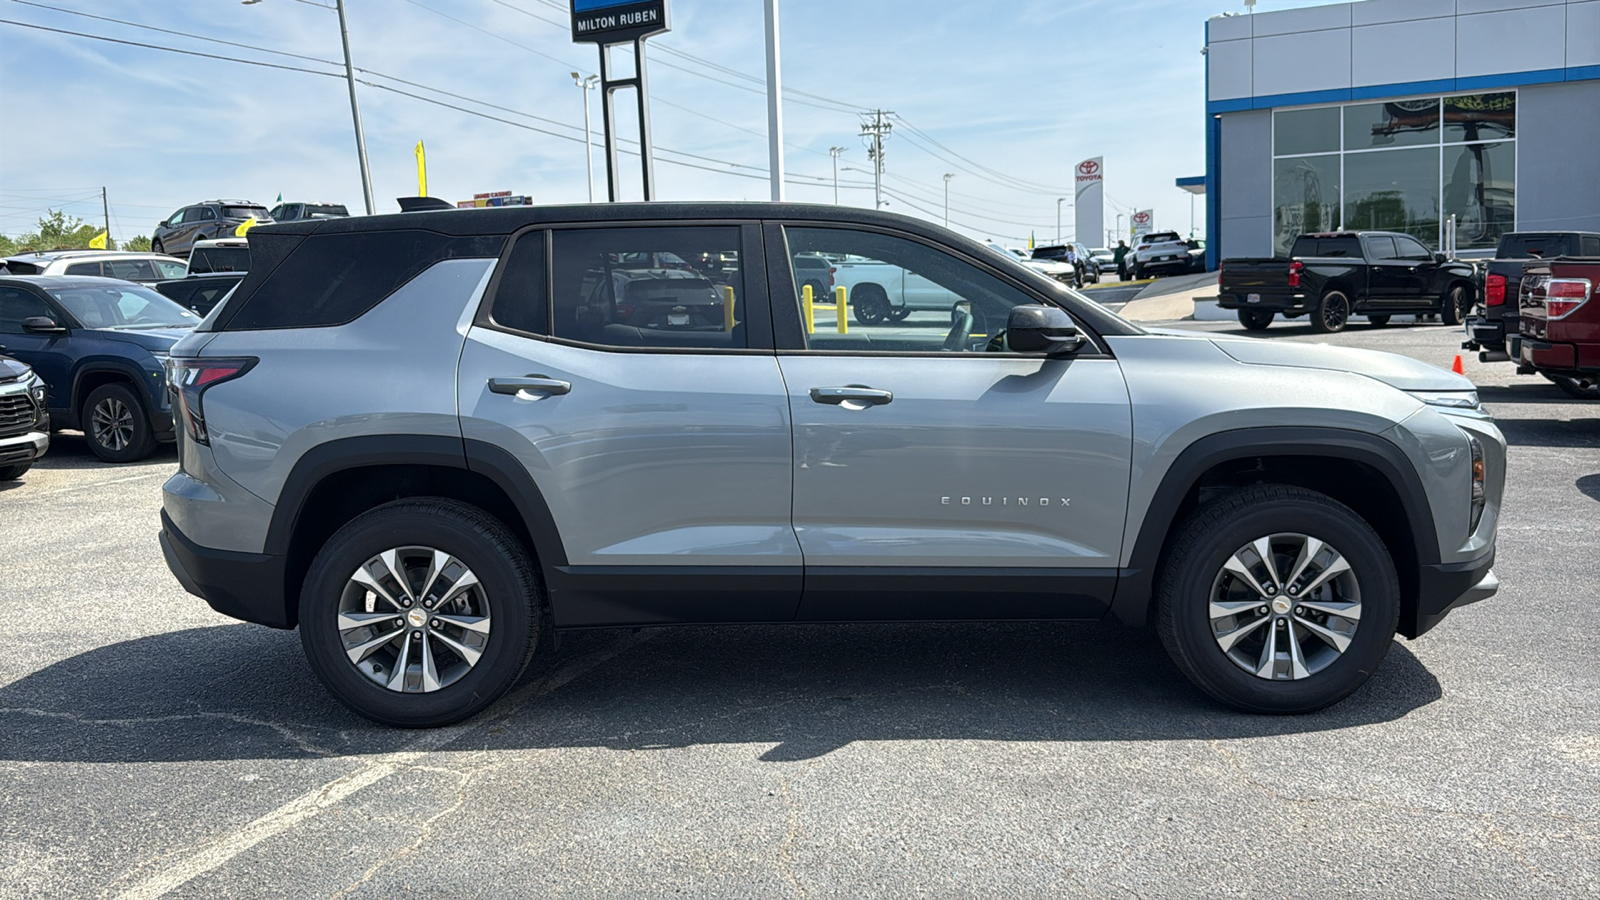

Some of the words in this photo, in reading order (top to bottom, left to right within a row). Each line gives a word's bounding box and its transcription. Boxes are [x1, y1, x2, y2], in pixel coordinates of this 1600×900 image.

[577, 15, 616, 32] MILTON
[620, 9, 657, 25] RUBEN
[1076, 174, 1103, 182] TOYOTA
[941, 496, 1071, 507] EQUINOX
